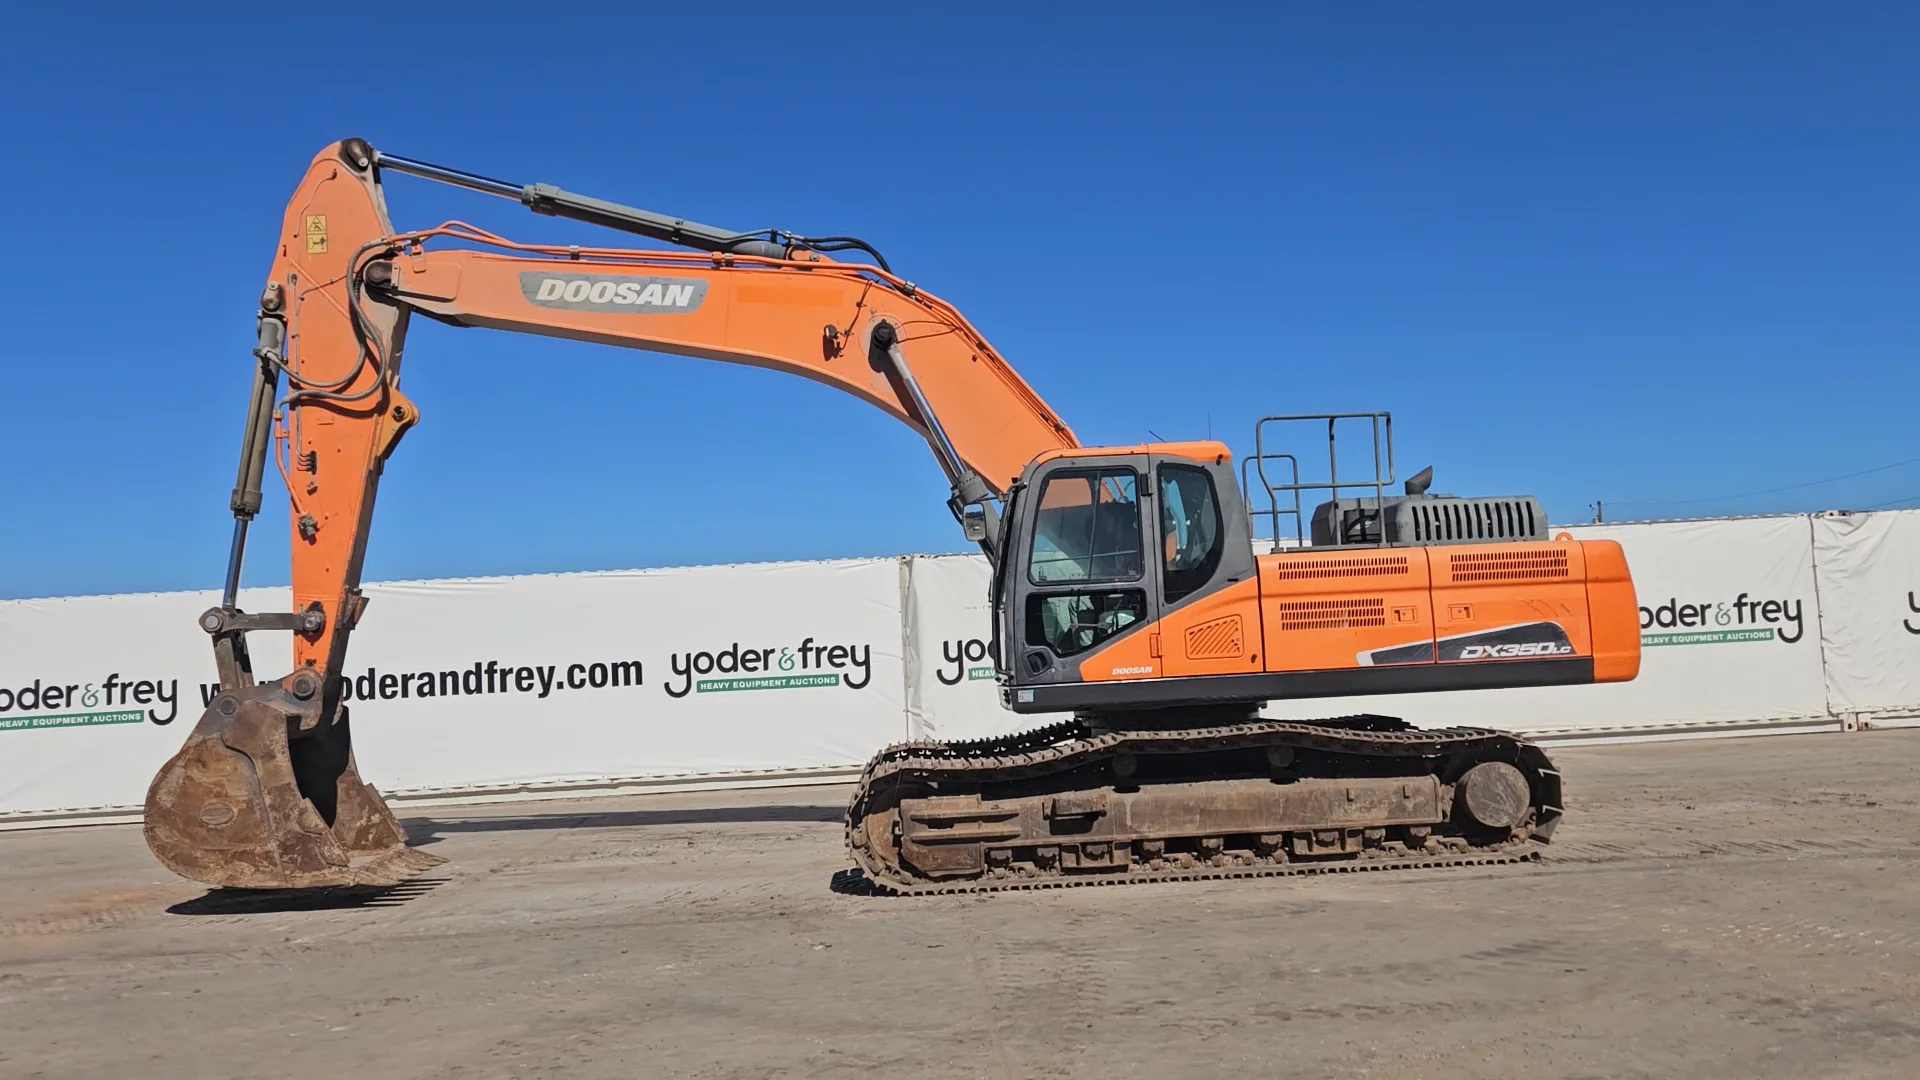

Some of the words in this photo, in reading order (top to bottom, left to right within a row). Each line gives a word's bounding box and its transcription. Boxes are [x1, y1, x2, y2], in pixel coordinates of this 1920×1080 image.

[536, 279, 694, 307] DOOSAN
[1642, 636, 1670, 645] HEAVY
[1672, 633, 1724, 643] EQUIPMENT
[1726, 630, 1771, 640] AUCTIONS
[971, 669, 995, 678] HEAV
[1112, 666, 1153, 676] DOOSAN
[700, 681, 729, 691] HEAVY
[733, 678, 786, 689] EQUIPMENT
[789, 676, 837, 686] AUCTIONS
[0, 719, 30, 728] HEAVY
[32, 715, 89, 726] EQUIPMENT
[92, 712, 142, 723] AUCTIONS
